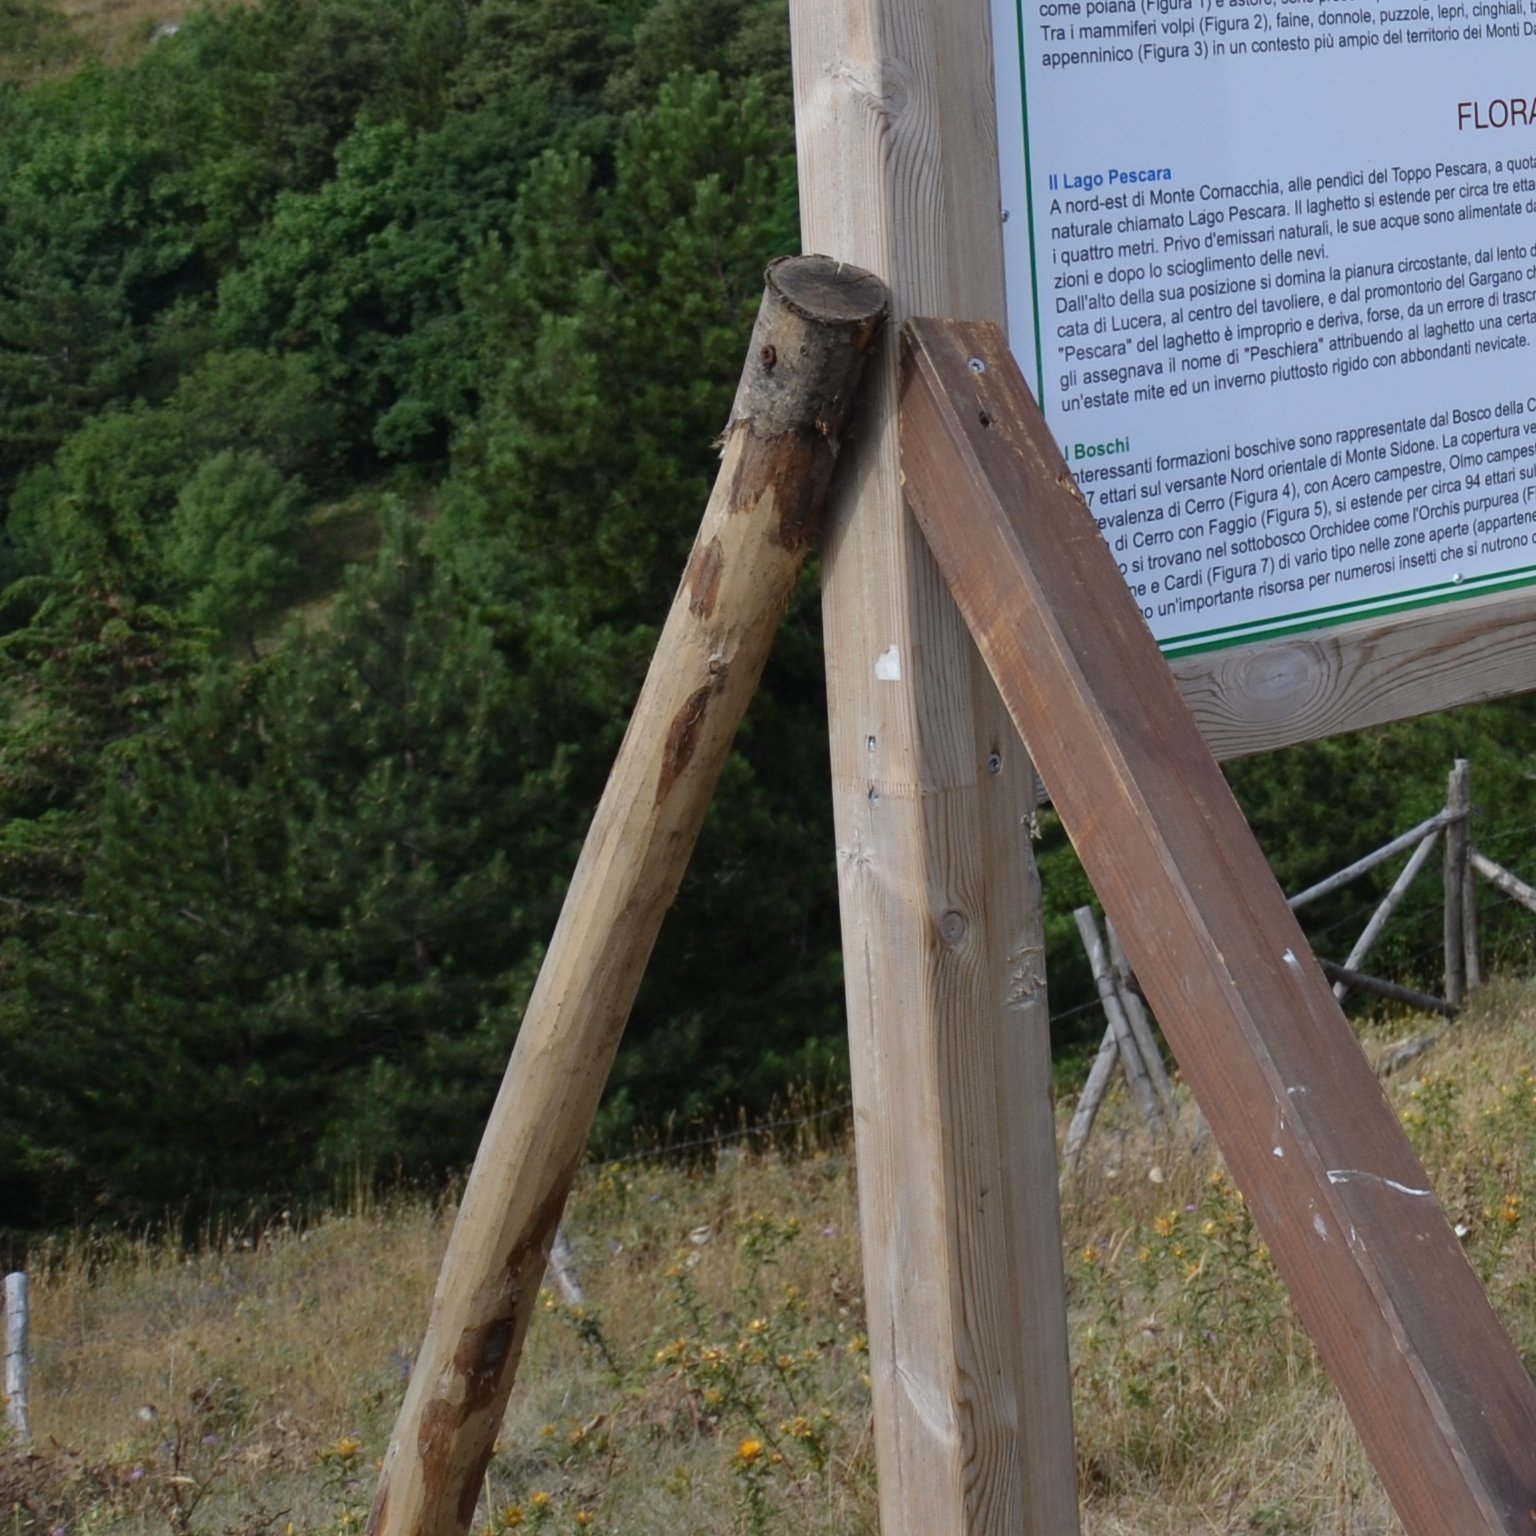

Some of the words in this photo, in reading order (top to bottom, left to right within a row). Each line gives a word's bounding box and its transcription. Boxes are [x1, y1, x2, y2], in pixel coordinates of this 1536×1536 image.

[1042, 46, 1134, 70] appenninico
[1138, 43, 1189, 64] (Figura
[1193, 40, 1209, 60] 3)
[1212, 40, 1225, 56] in
[1229, 41, 1247, 54] un
[1251, 36, 1310, 53] contesto
[1314, 33, 1334, 53] più
[1338, 30, 1379, 50] ampio
[1382, 29, 1402, 45] del
[1406, 26, 1460, 43] territorio
[1462, 24, 1482, 40] dei
[1485, 22, 1520, 38] Monti
[1048, 174, 1058, 190] Il
[1063, 173, 1104, 191] Lago
[1108, 168, 1171, 185] Pescara
[1054, 269, 1089, 289] zioni
[1094, 271, 1103, 285] e
[1107, 266, 1145, 284] dopo
[1149, 262, 1163, 278] lo
[1167, 253, 1256, 277] scioglimento
[1259, 248, 1293, 266] delle
[1297, 243, 1328, 261] nevi.
[1061, 389, 1130, 412] un'estate
[1134, 384, 1165, 402] mite
[1169, 379, 1187, 397] ed
[1192, 380, 1210, 394] un
[1214, 372, 1266, 390] inverno
[1270, 361, 1328, 386] piuttosto
[1332, 355, 1369, 376] rigido
[1372, 354, 1396, 368] con
[1400, 340, 1471, 364] abbondanti
[1475, 334, 1530, 353] nevicate.
[1074, 436, 1130, 460] Boschi
